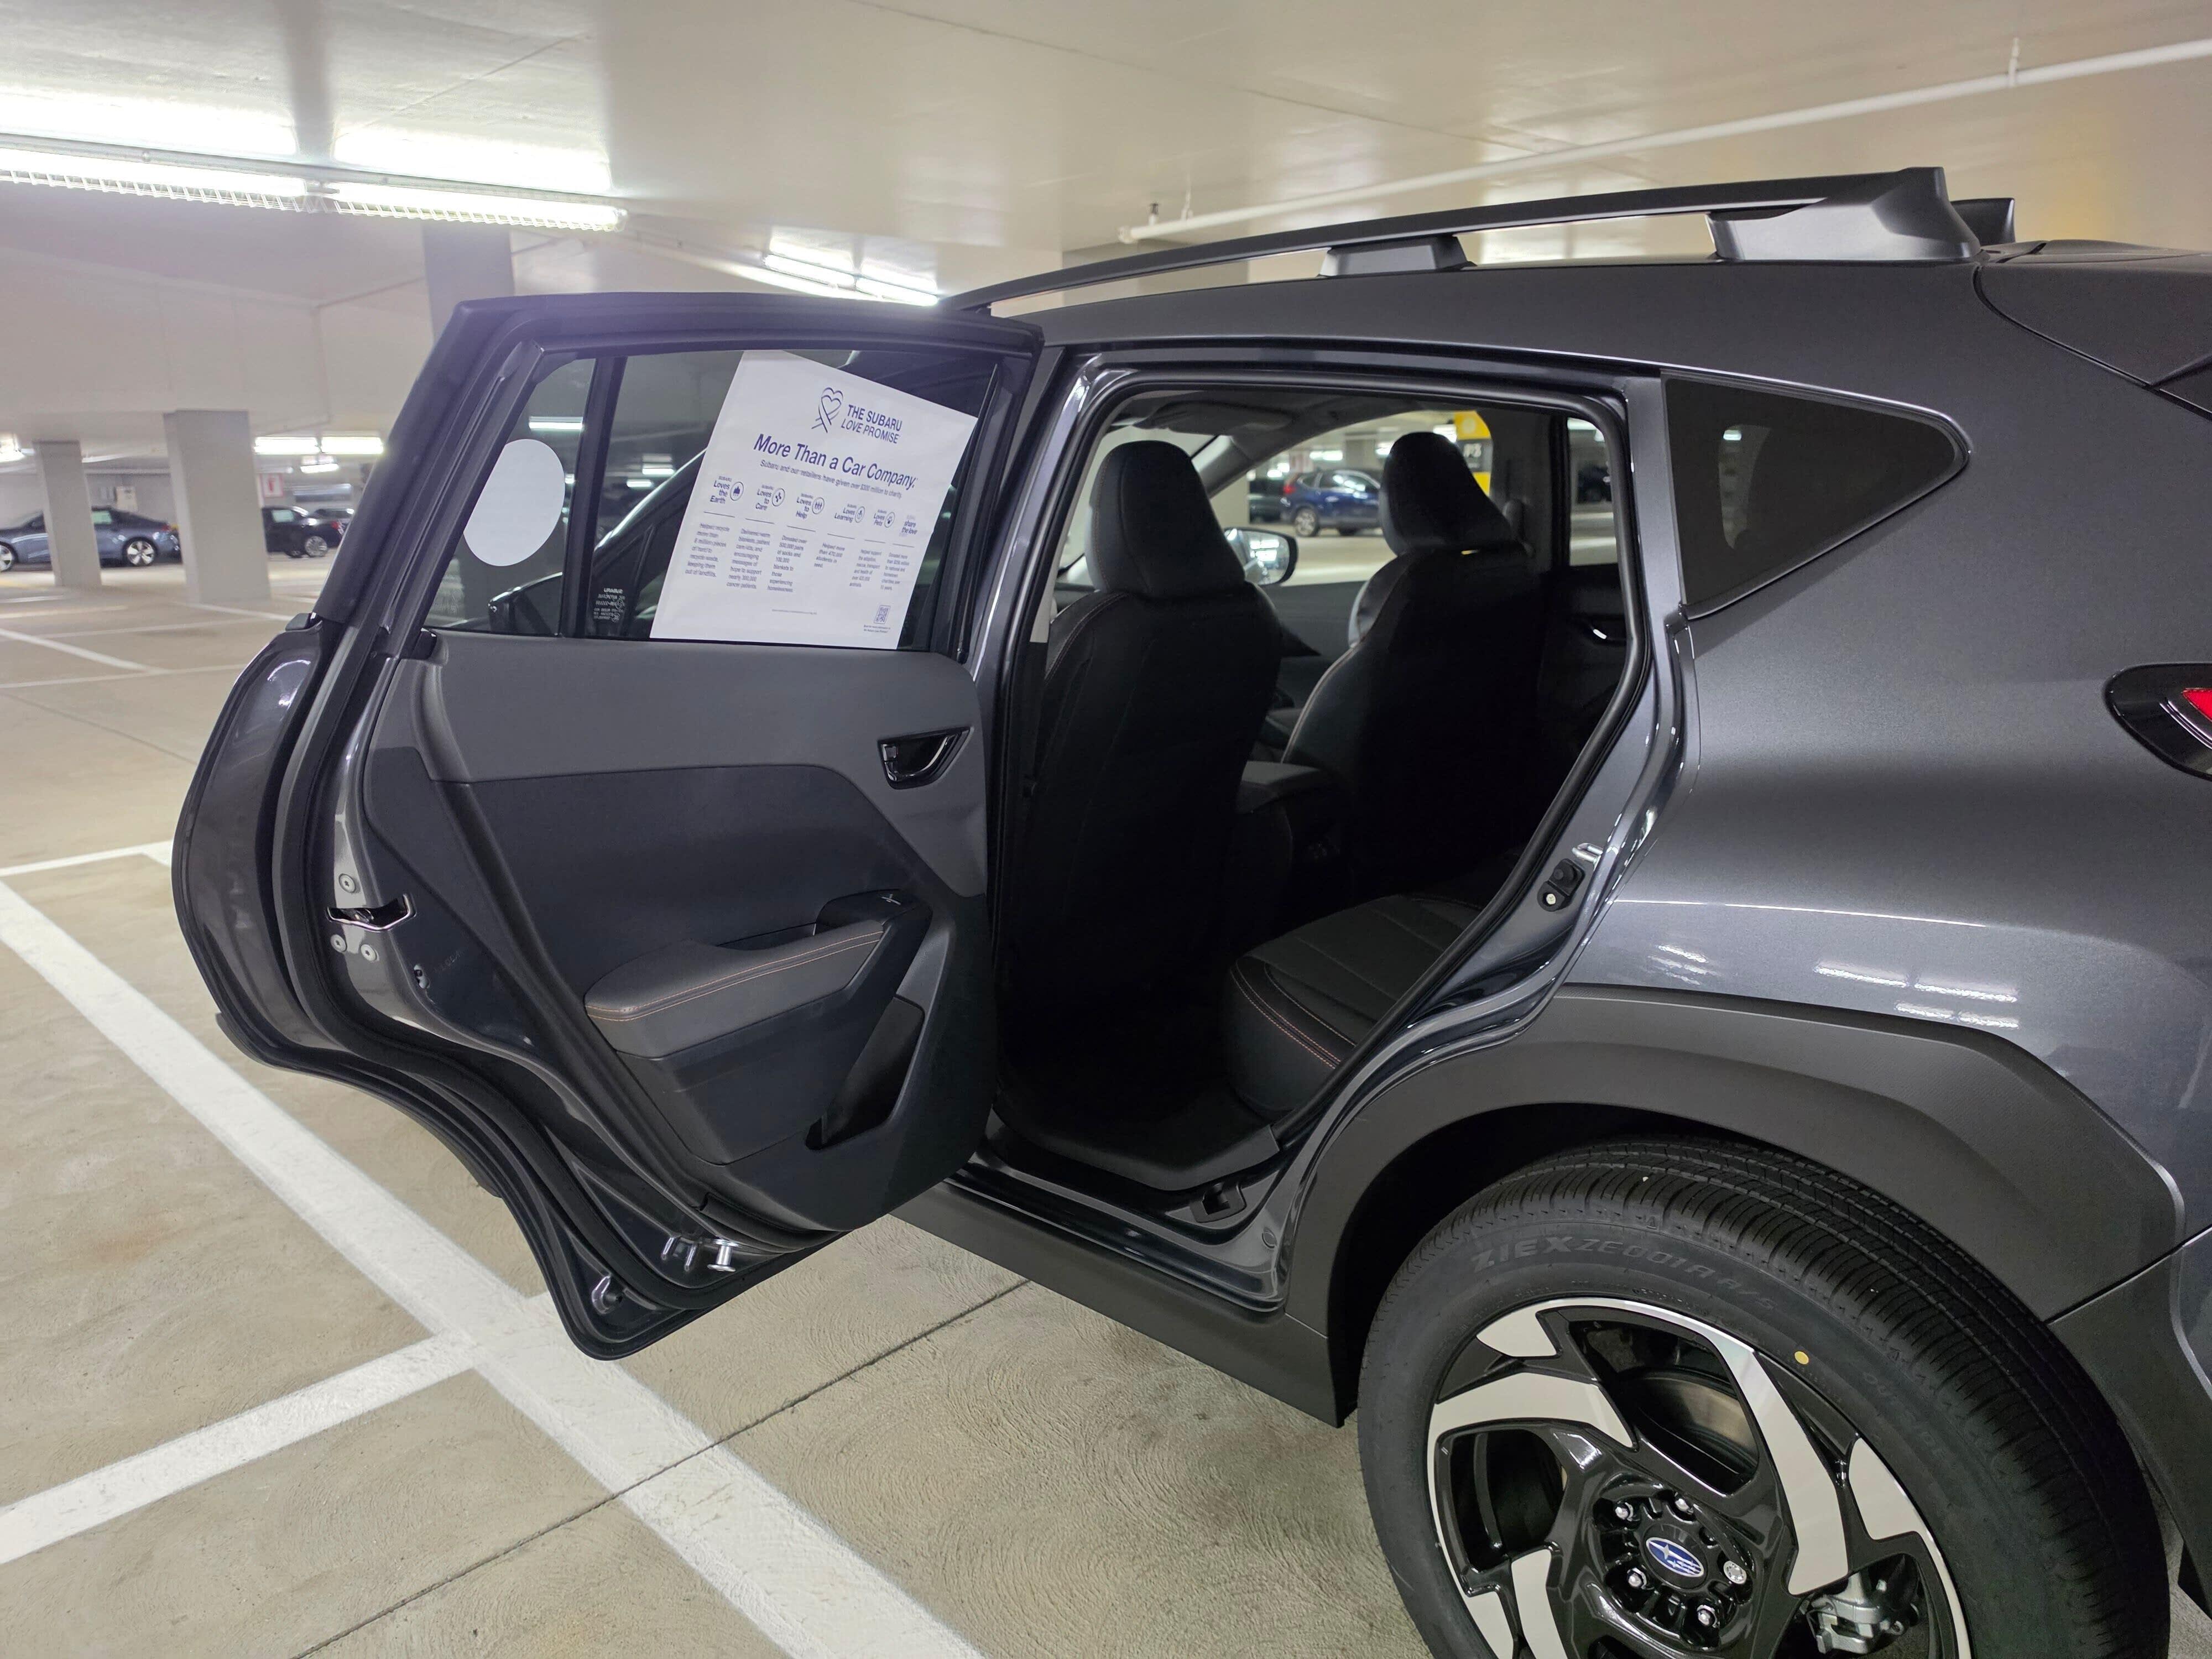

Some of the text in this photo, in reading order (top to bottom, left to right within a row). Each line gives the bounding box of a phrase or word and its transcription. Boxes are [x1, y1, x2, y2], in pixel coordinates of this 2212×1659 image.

[847, 404, 902, 431] THE SUBARU
[841, 419, 899, 444] LOVE PROMISE
[754, 434, 790, 457] More
[795, 444, 826, 466] Than
[829, 457, 838, 469] a
[842, 457, 865, 476] Car
[713, 480, 729, 489] Loves
[757, 489, 771, 497] Loves
[796, 497, 811, 505] Loves
[796, 510, 807, 519] Help
[834, 513, 853, 523] Learning
[1469, 1236, 1573, 1272] ZIEX
[1572, 1238, 1716, 1279] ZE001A
